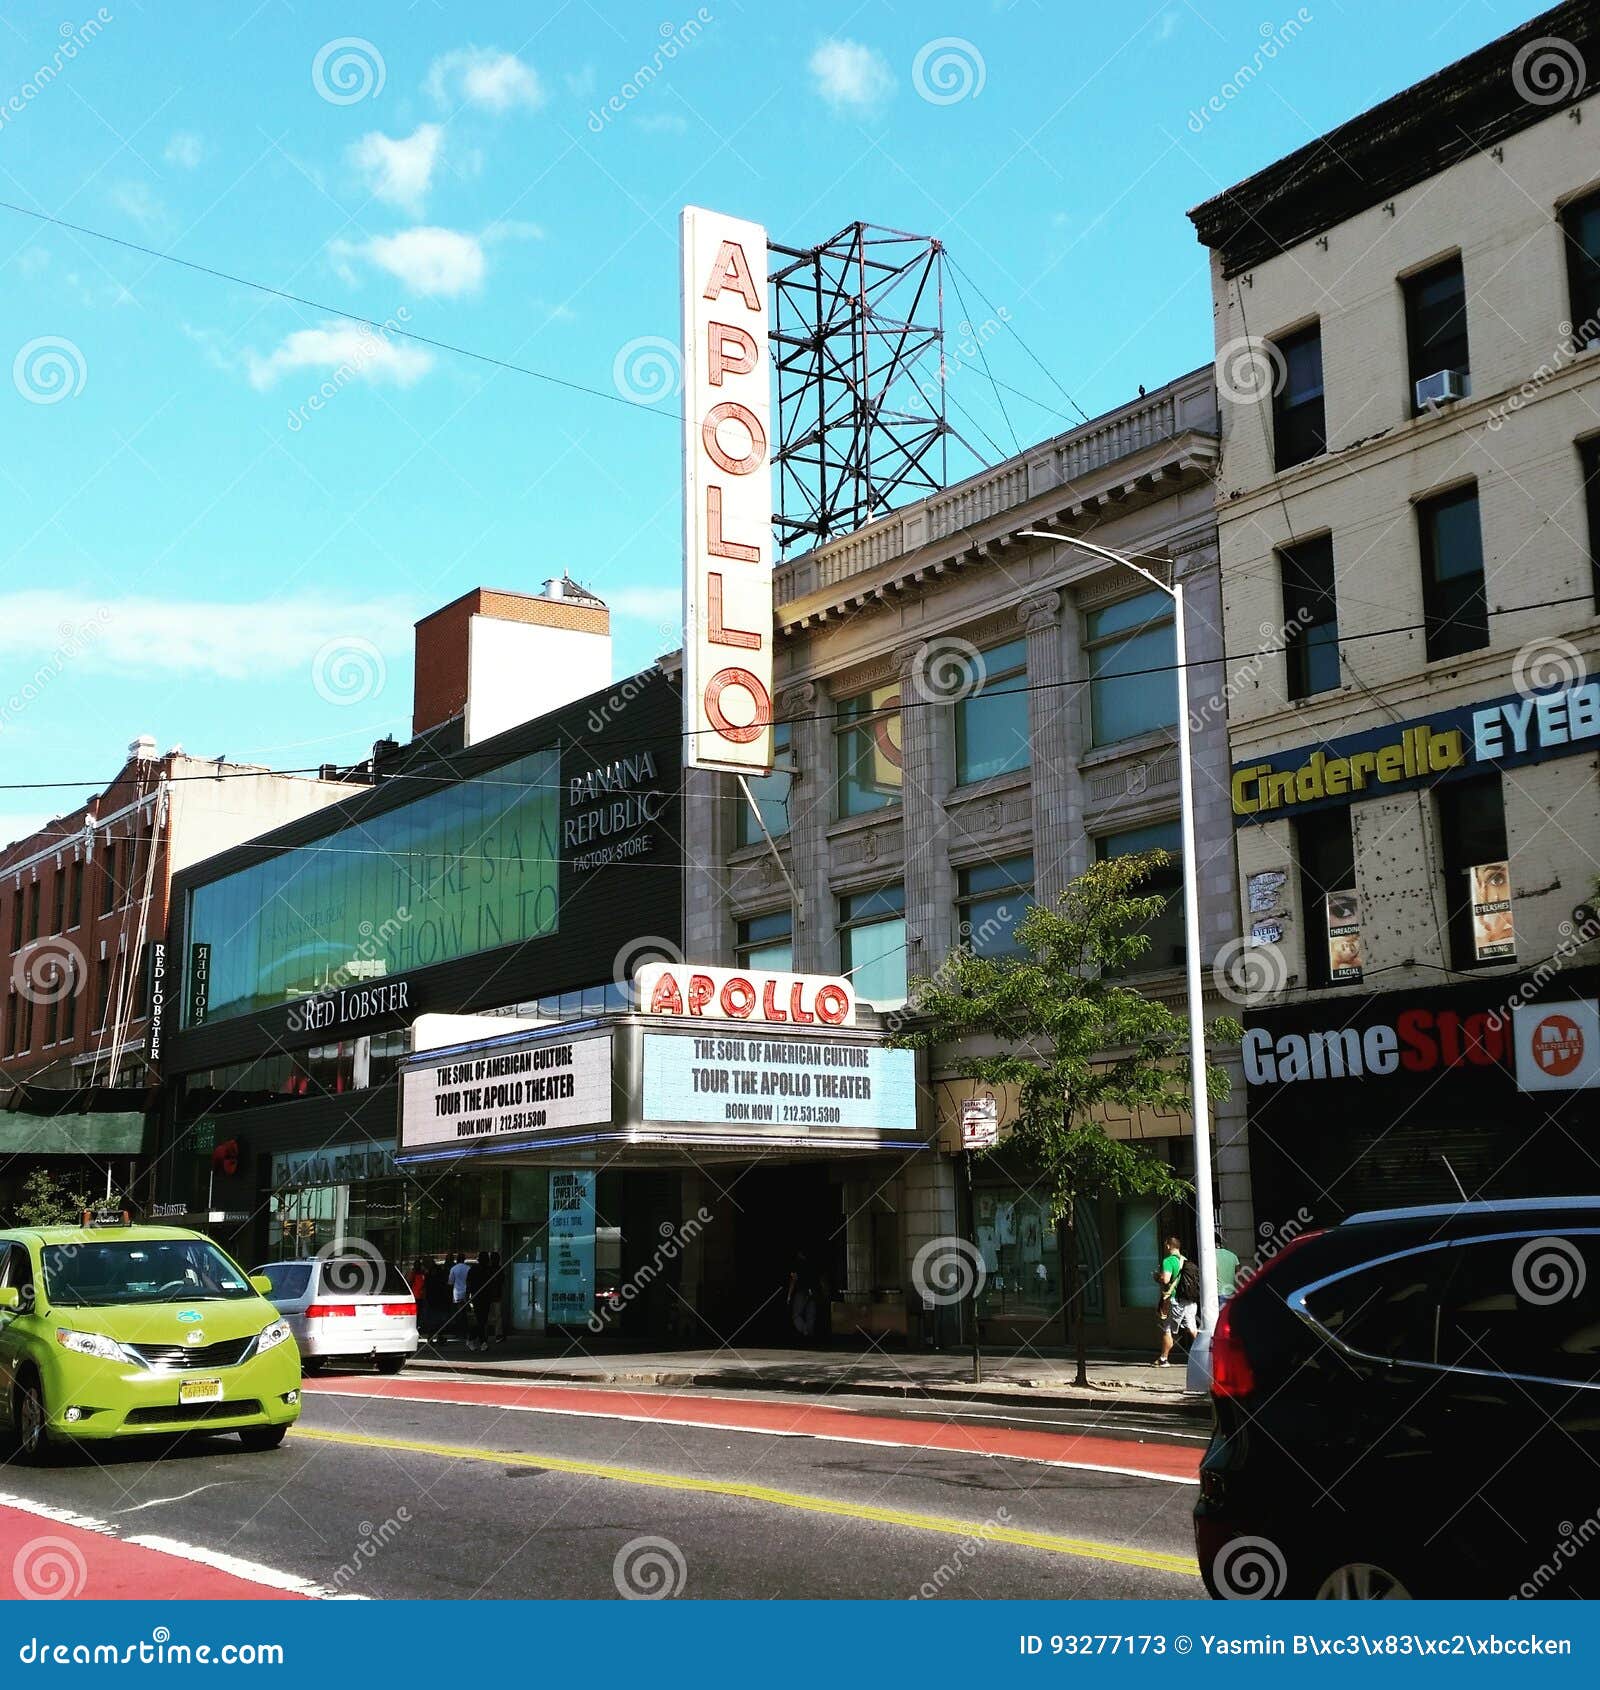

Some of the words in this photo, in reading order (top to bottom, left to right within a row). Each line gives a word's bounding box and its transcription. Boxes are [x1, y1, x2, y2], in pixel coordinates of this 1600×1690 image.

[703, 240, 771, 743] APOLLO
[1232, 725, 1464, 815] Cinderella
[1473, 683, 1600, 762] EYEB
[570, 751, 657, 806] BANANA
[564, 791, 660, 848] REPUBLIC
[573, 845, 614, 873] FACTORY
[616, 834, 653, 860] STORE
[1475, 902, 1510, 914] EYELASHES
[386, 910, 466, 974] SHOW
[478, 898, 504, 950] IN
[154, 944, 165, 978] RED
[1338, 968, 1360, 977] FACIAL
[304, 999, 335, 1031] RED
[340, 981, 409, 1023] LOBSTER
[651, 972, 849, 1025] APOLLO
[150, 980, 164, 1060] LOBSTER
[437, 1066, 451, 1087] THE
[453, 1064, 474, 1085] SOUL
[475, 1062, 485, 1081] OF
[487, 1052, 532, 1079] AMERICAN
[533, 1045, 573, 1071] CULTURE
[694, 1039, 715, 1060] THE
[717, 1041, 746, 1062] SOUL
[749, 1043, 764, 1063] OF
[764, 1043, 821, 1066] AMERICAN
[823, 1047, 869, 1068] CULTURE
[1535, 1041, 1583, 1051] MERRELL
[435, 1092, 461, 1117] TOUR
[463, 1087, 482, 1112] THE
[483, 1081, 523, 1109] APOLLO
[525, 1073, 575, 1103] THEATER
[691, 1068, 729, 1094] TOUR
[732, 1070, 758, 1095] THE
[760, 1071, 811, 1098] APOLLO
[813, 1074, 871, 1100] THEATER
[457, 1121, 474, 1137] BOOK
[476, 1117, 492, 1134] NOW
[500, 1110, 546, 1131] 212.531.5300
[725, 1103, 750, 1120] BOOK
[751, 1104, 773, 1121] NOW
[783, 1105, 840, 1123] 212.531.5300
